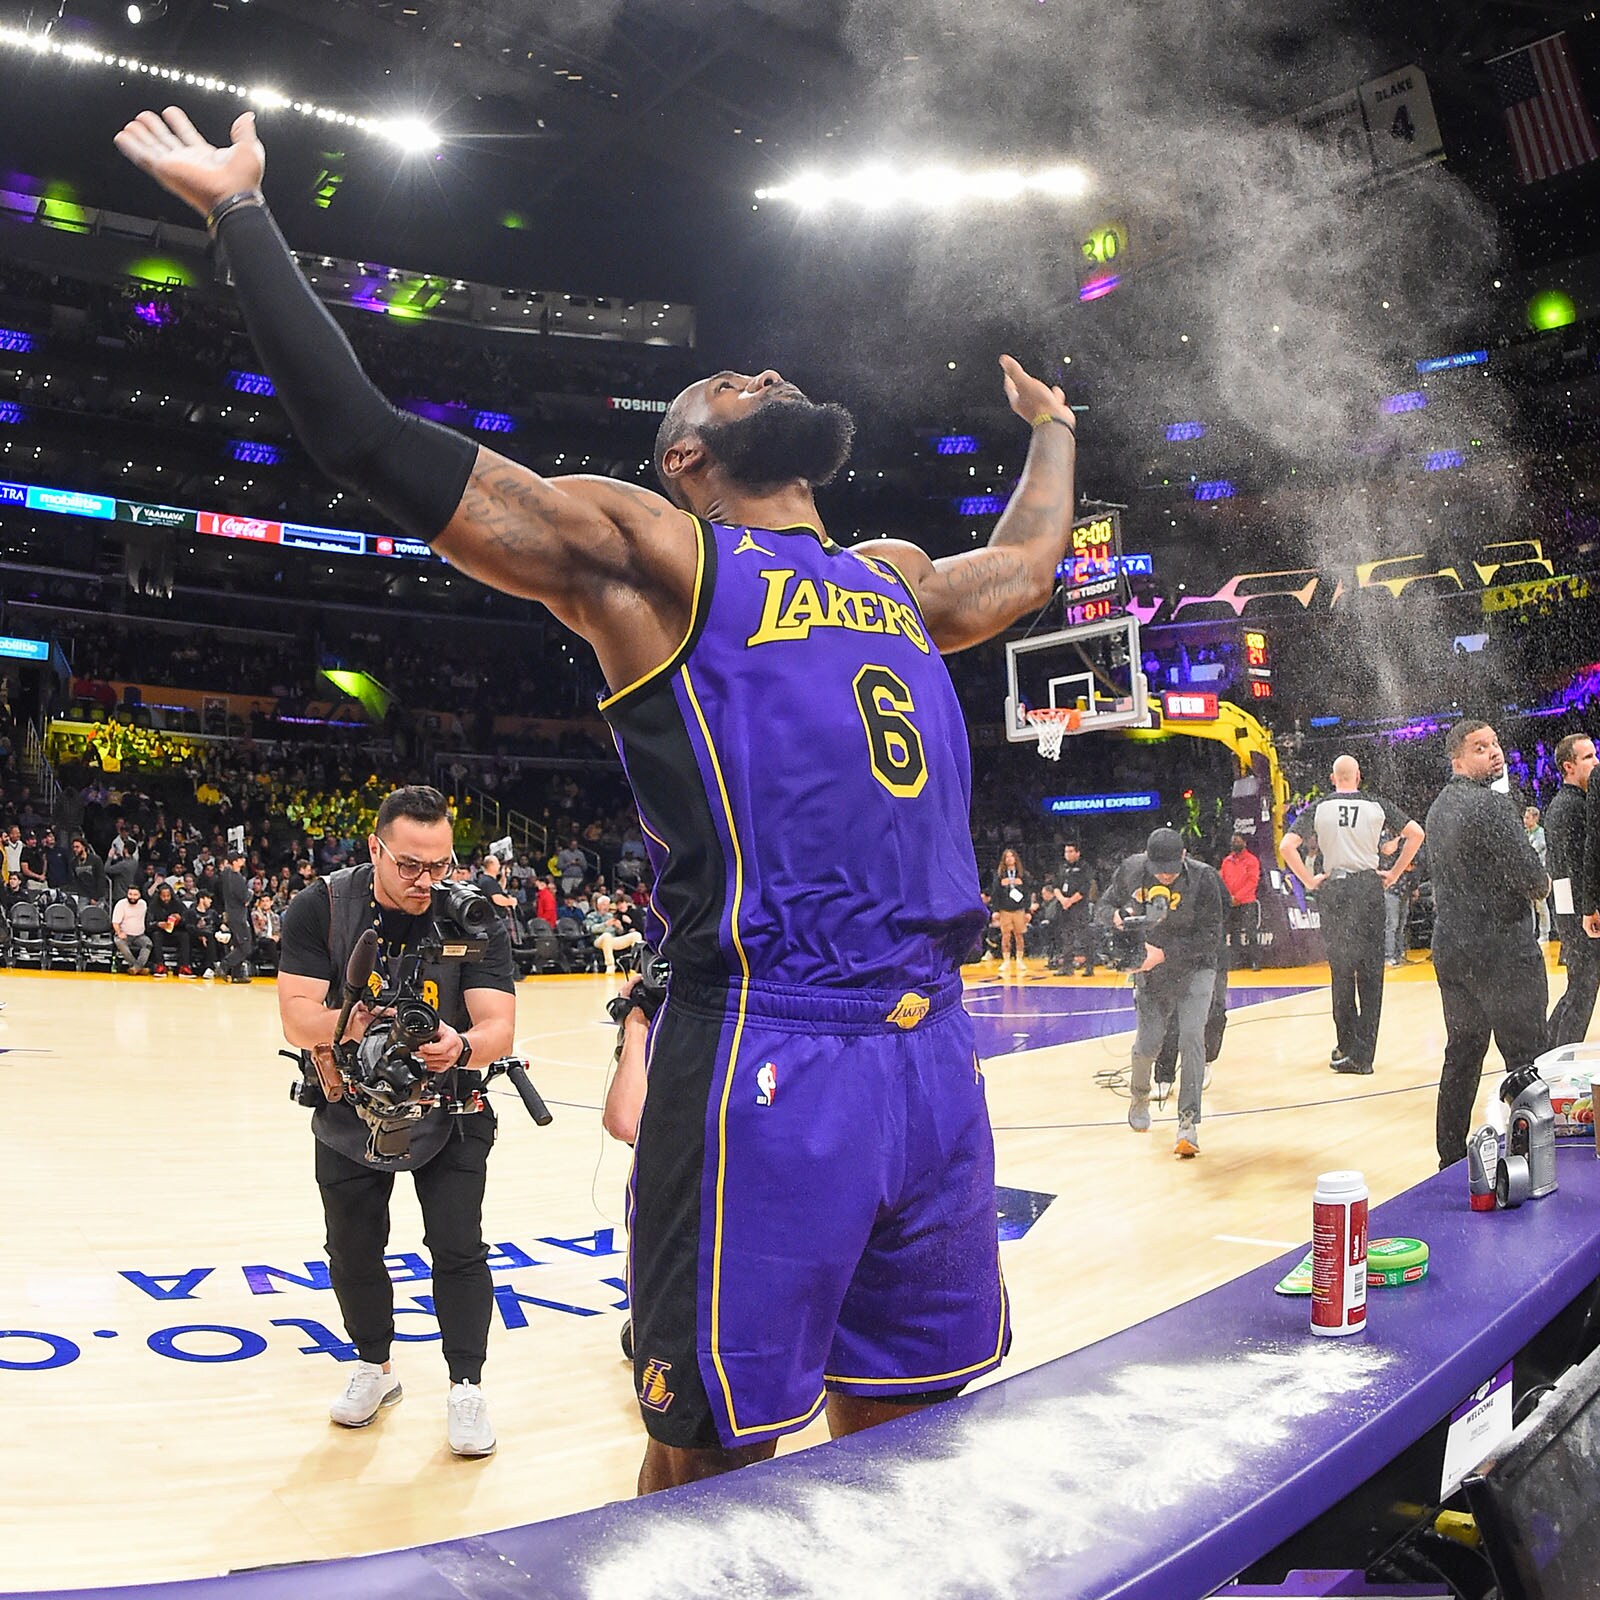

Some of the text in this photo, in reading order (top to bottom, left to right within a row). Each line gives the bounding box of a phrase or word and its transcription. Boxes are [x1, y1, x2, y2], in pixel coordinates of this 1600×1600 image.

[1375, 77, 1414, 104] BLAKE
[1391, 104, 1415, 144] 4
[611, 397, 671, 413] TOSHIB
[0, 487, 24, 501] TRA
[1072, 520, 1111, 549] 12:00
[394, 543, 431, 556] TOYOTA
[1074, 543, 1109, 584] 24
[1080, 579, 1118, 598] TISSOT
[746, 568, 930, 655] LAKERS
[852, 663, 929, 799] 6
[1052, 796, 1151, 811] AMERICAN EXPRESS
[1338, 805, 1359, 828] 37
[1466, 1398, 1495, 1425] WELCOME
